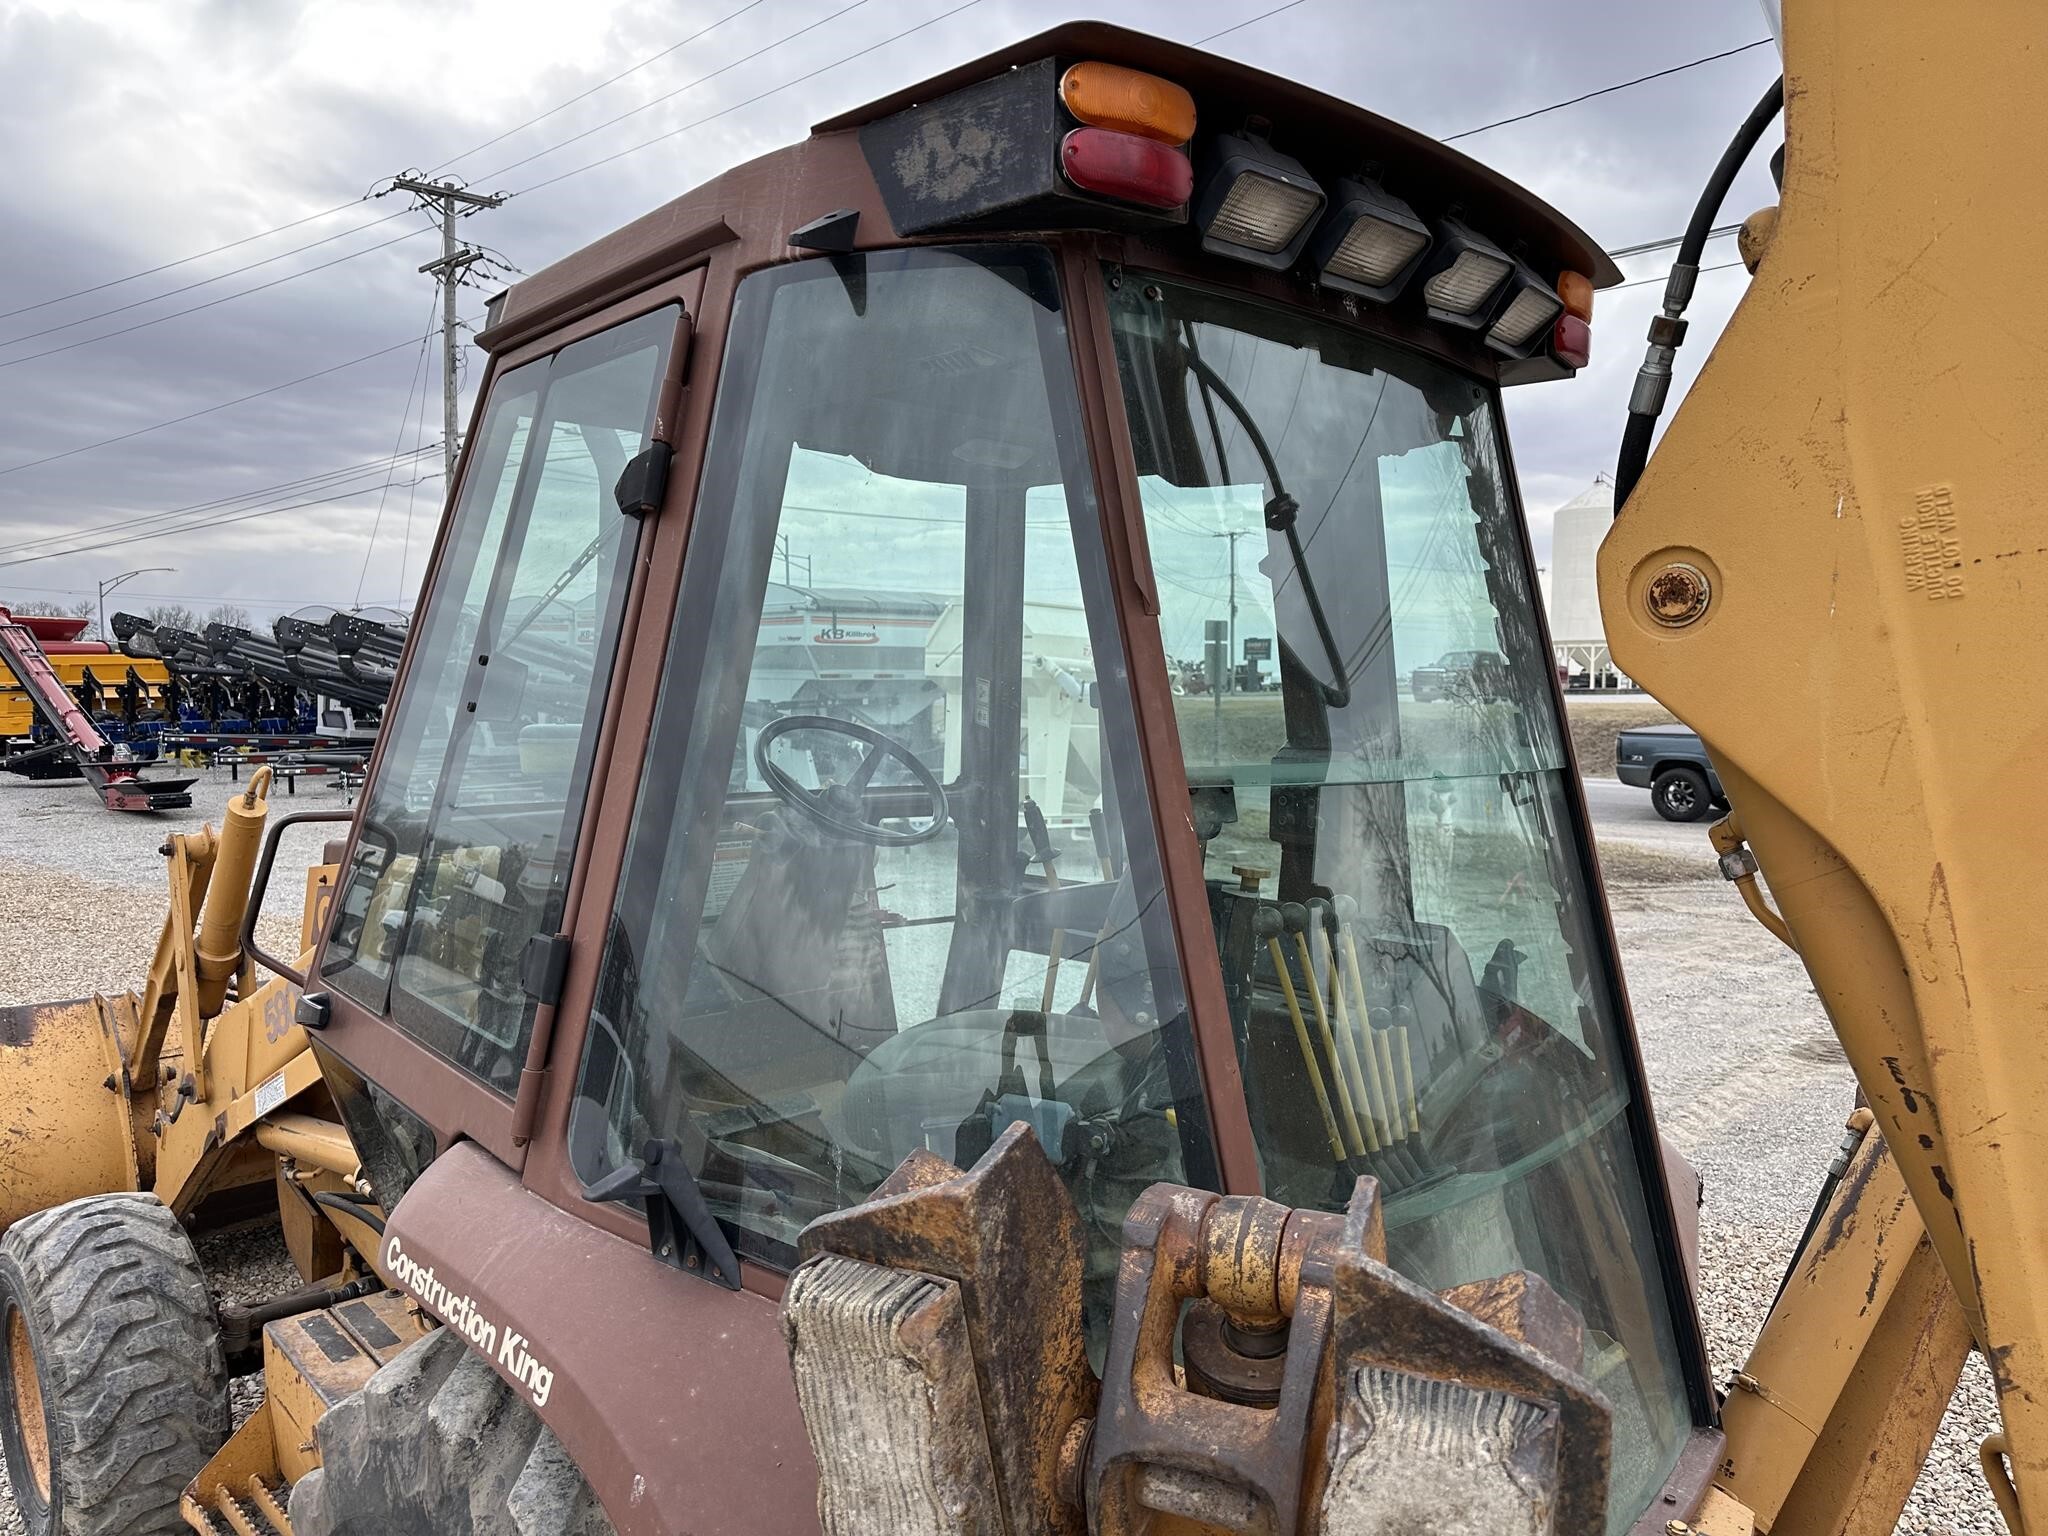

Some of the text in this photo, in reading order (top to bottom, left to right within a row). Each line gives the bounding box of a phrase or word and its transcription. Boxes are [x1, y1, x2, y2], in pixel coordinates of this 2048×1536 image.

[1900, 516, 1925, 592] WARNING
[1915, 489, 1946, 601] DUCTILE IRON
[1934, 485, 1965, 600] DO NOT WELD
[821, 628, 845, 639] KB
[386, 1236, 554, 1407] Construction King
